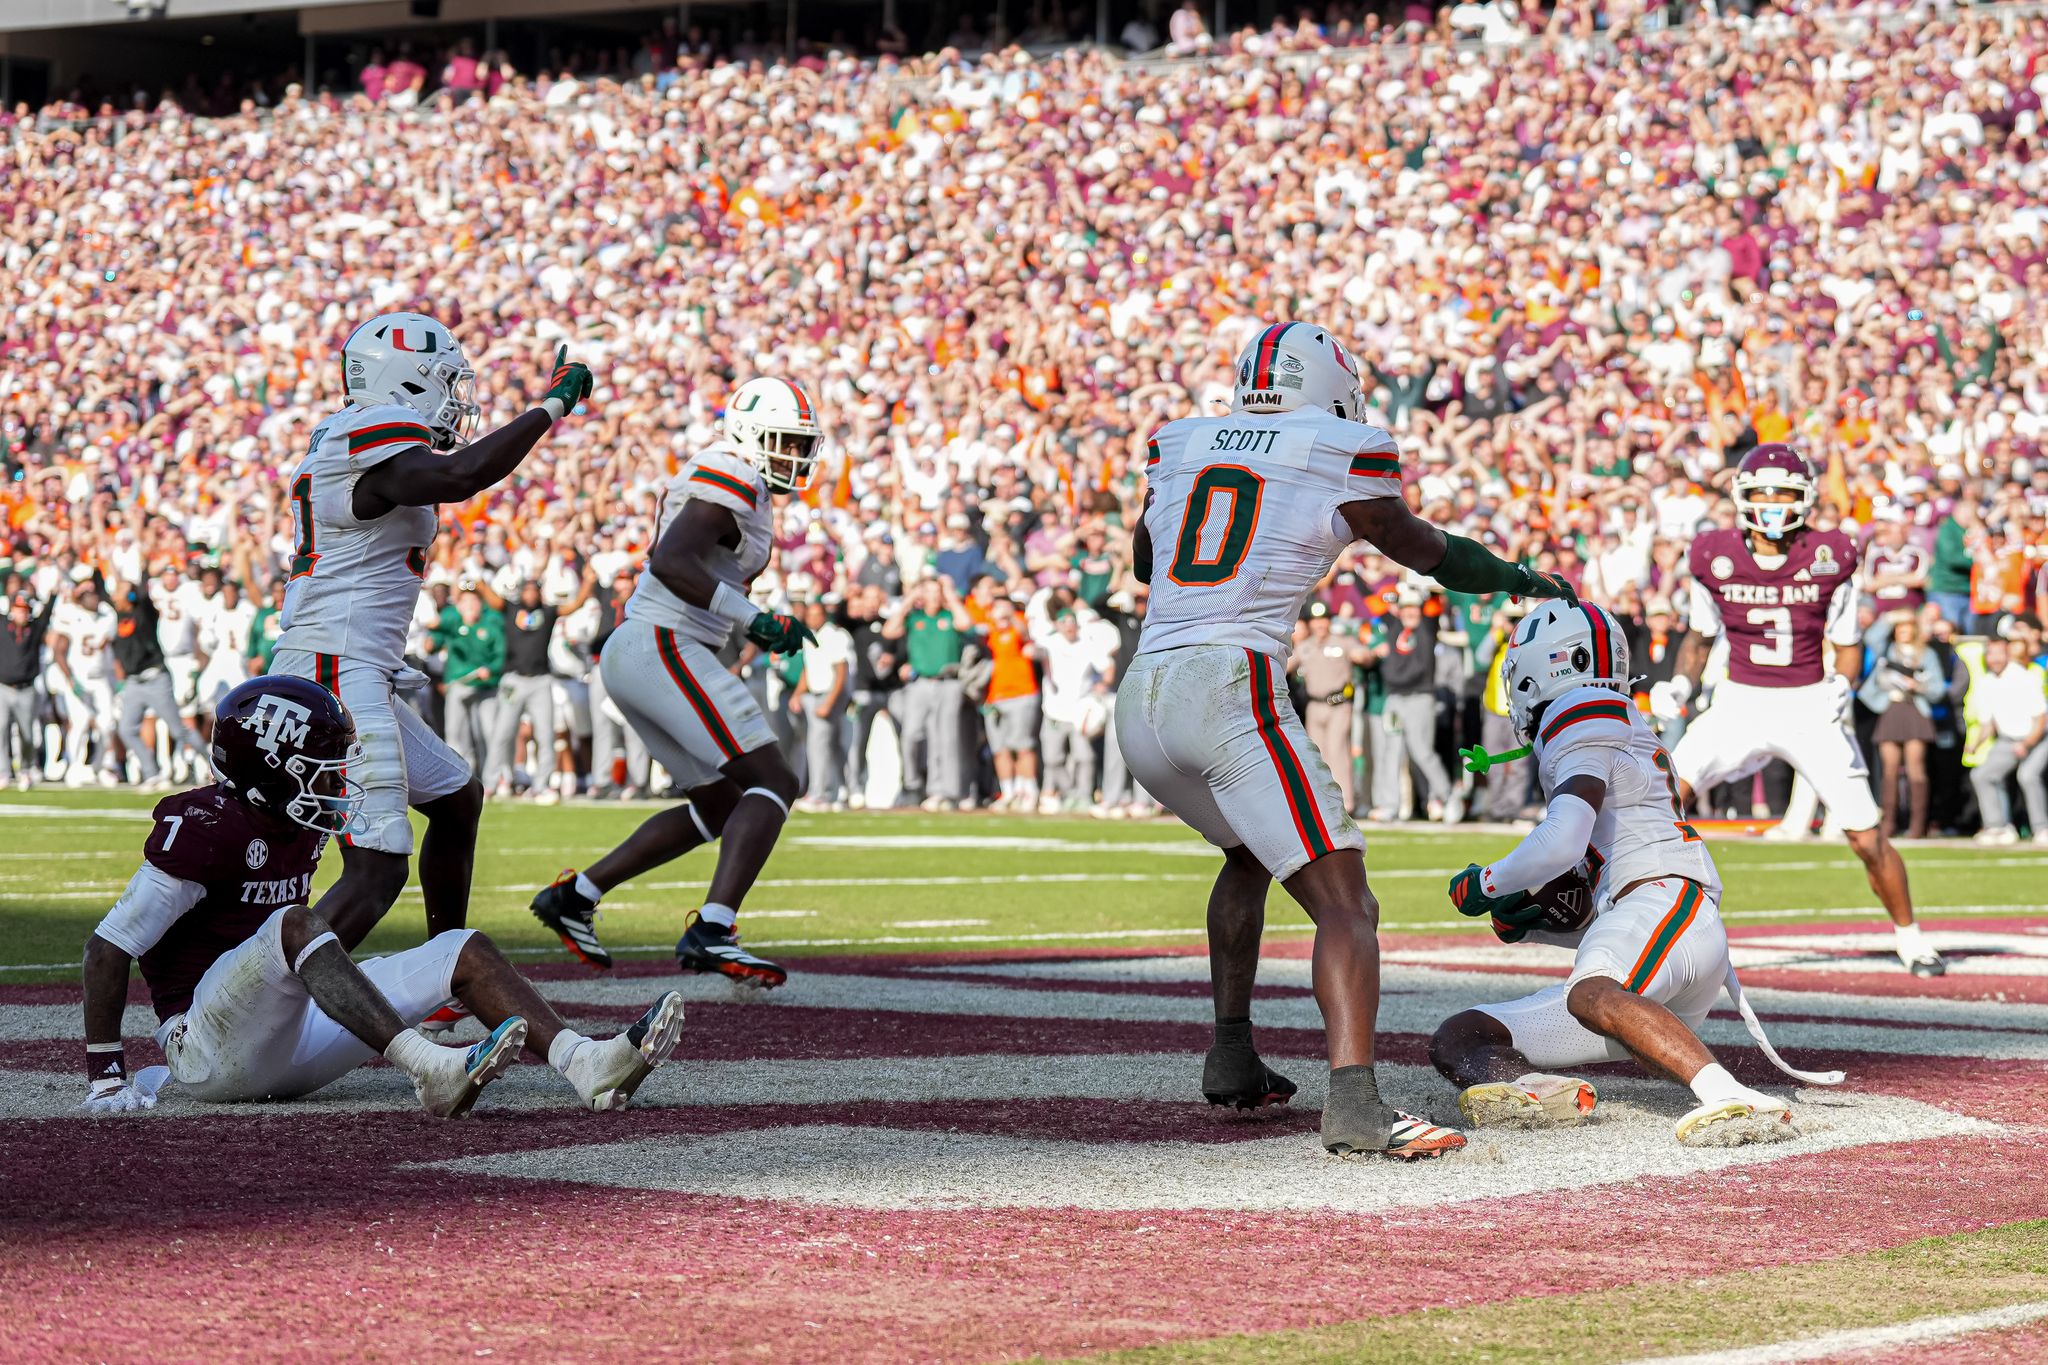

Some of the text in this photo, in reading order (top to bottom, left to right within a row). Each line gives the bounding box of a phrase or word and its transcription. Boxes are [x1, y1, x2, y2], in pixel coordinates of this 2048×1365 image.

[1241, 393, 1283, 406] MIAMI
[1210, 429, 1280, 454] SCOTT
[1167, 463, 1266, 587] 0
[1718, 583, 1779, 605] TEXAS
[1746, 606, 1794, 667] 3
[162, 815, 183, 851] 7
[247, 841, 267, 868] SEC
[240, 876, 298, 904] TEXAS
